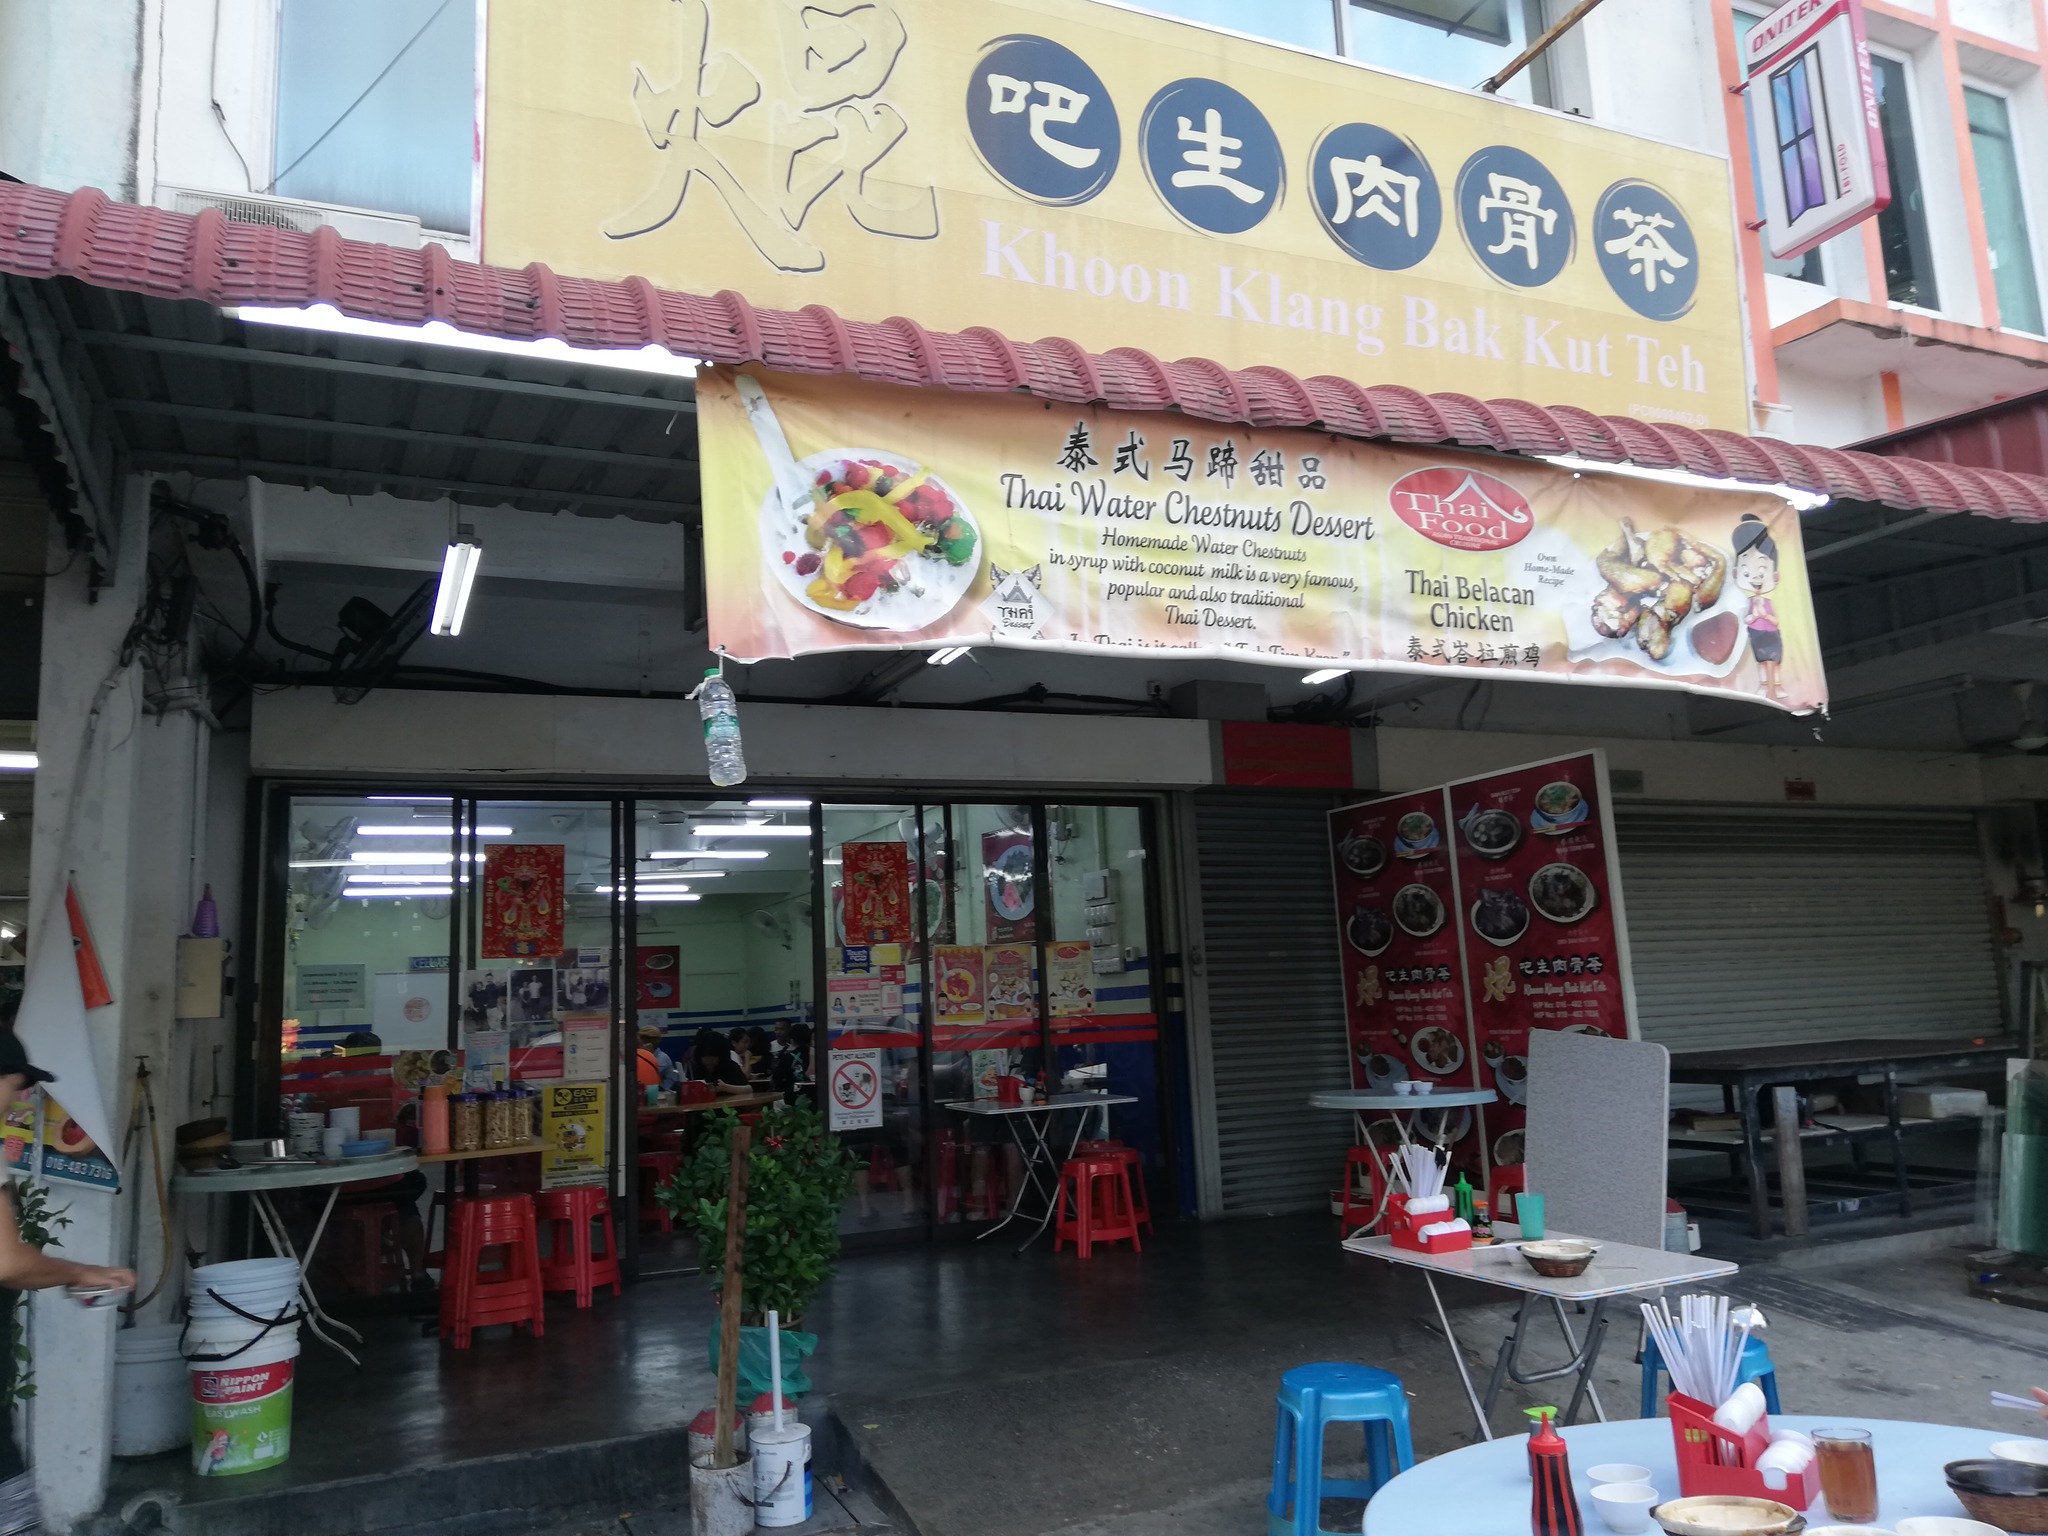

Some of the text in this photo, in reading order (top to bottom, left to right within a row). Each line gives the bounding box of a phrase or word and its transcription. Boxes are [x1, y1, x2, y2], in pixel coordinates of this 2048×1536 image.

[1857, 40, 1879, 129] ONITEK
[986, 73, 1689, 293] 吧生肉骨茶
[980, 219, 1708, 394] Khoon Klang Bak Kut Teh
[1056, 420, 1327, 490] 泰式马蹄甜品
[1000, 472, 1376, 542] Thai Water Chestnuts Dessert
[1395, 490, 1490, 519] Thai
[1416, 510, 1510, 541] Food
[1101, 527, 1308, 562] Homemade Water Chestnuts
[1049, 548, 1360, 593] in syrup with coconut milk is a very famous,
[1524, 562, 1576, 576] Home-Made
[1106, 579, 1306, 610] popular and also traditional
[1404, 569, 1536, 607] Thai Belacan
[1164, 604, 1258, 631] Thai Dessert.
[1429, 602, 1514, 633] Chicken
[220, 1372, 270, 1387] NIPPON
